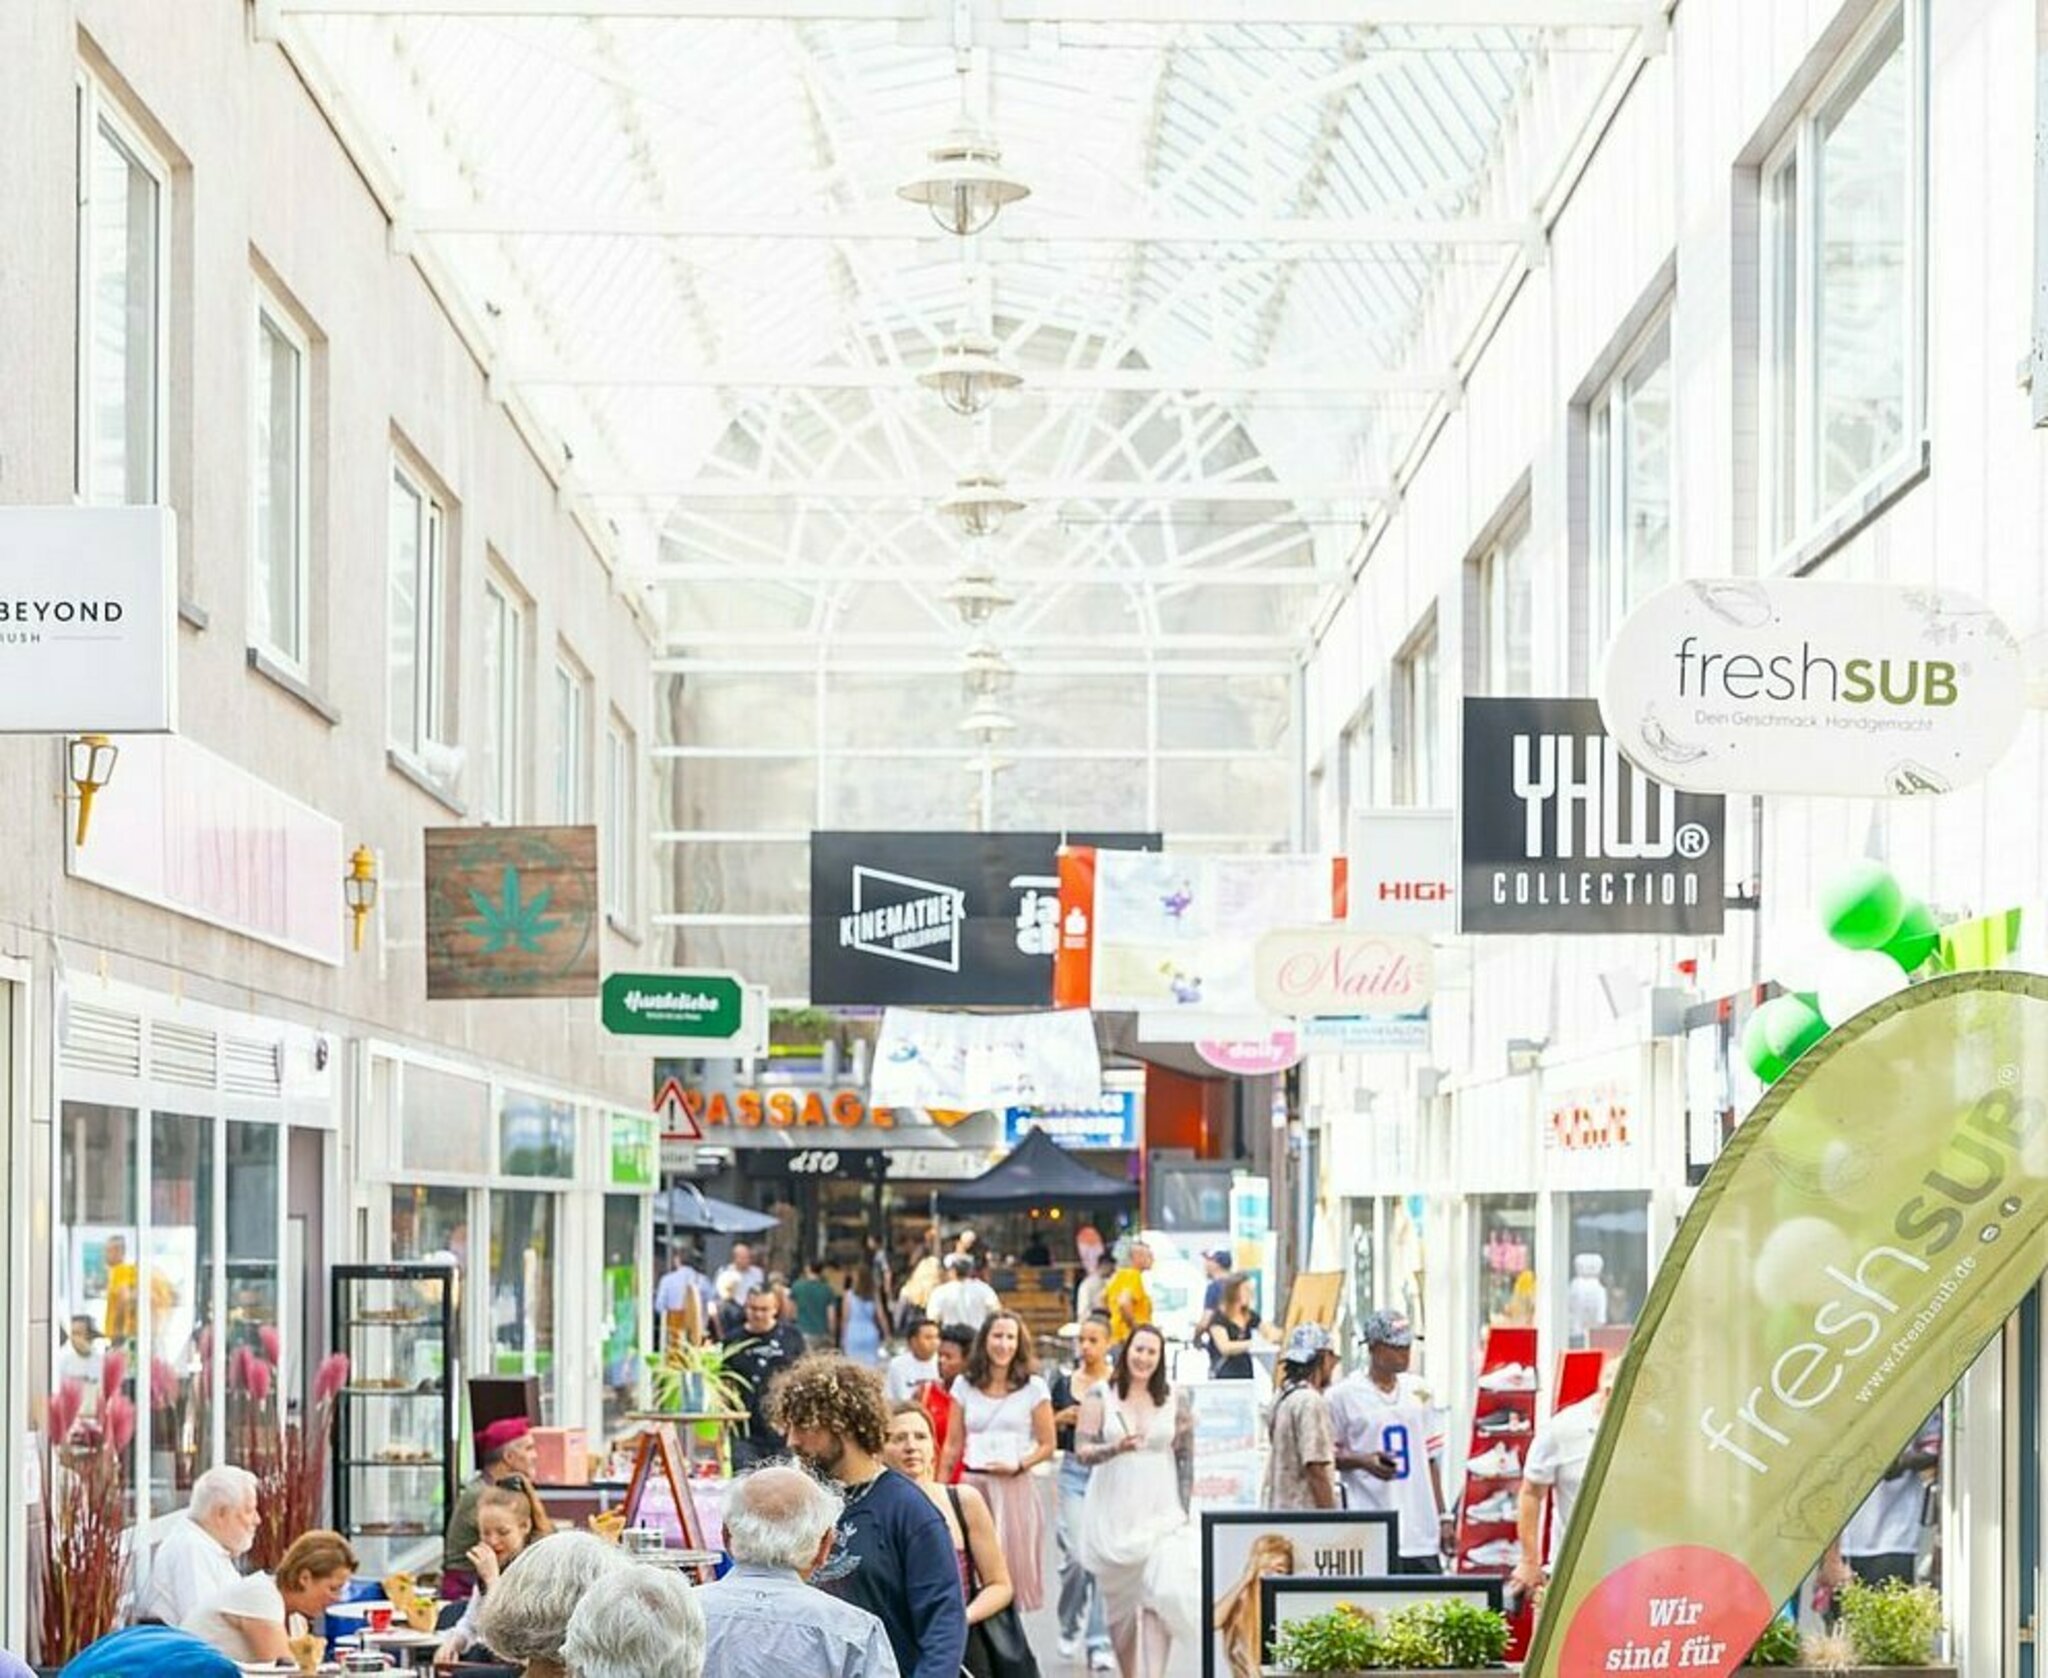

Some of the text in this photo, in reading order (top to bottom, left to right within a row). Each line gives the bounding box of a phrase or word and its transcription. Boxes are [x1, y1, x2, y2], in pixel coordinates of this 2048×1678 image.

[0, 601, 123, 622] BEYOND
[1694, 709, 1729, 725] Dein
[1493, 872, 1699, 906] COLLECTION
[1278, 940, 1413, 999] Nails
[1855, 1255, 1977, 1404] www.freshsub.de
[1648, 1596, 1703, 1627] Wir
[1605, 1634, 1727, 1671] sind für
